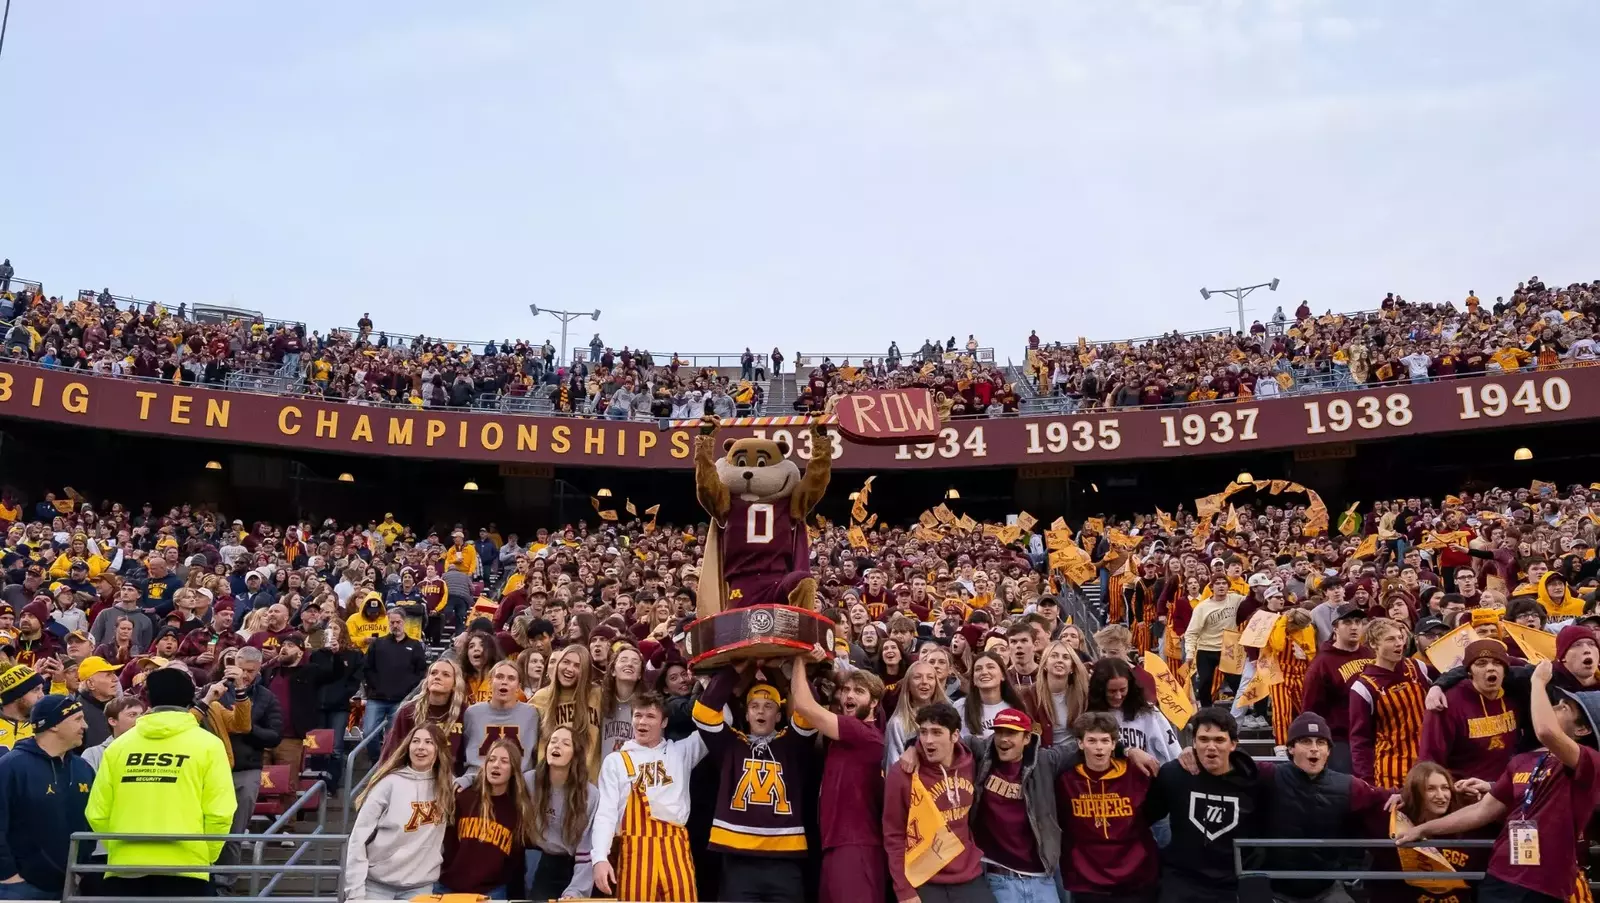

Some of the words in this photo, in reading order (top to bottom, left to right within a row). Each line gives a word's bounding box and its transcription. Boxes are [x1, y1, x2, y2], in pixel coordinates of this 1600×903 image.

[0, 372, 89, 414] BIG
[136, 391, 231, 428] TEN
[278, 405, 690, 459] CHAMPIONSHIPS
[851, 391, 935, 433] ROW
[1304, 392, 1413, 434] 1938
[1456, 376, 1572, 420] 1940
[1025, 419, 1122, 454] 1935
[1160, 407, 1259, 447] 1937
[746, 503, 774, 544] 0
[730, 588, 743, 600] M
[357, 624, 388, 633] MICHIGAN
[126, 753, 190, 767] BEST
[78, 782, 89, 793] M
[730, 758, 793, 815] M
[1071, 797, 1134, 818] GOPHERS
